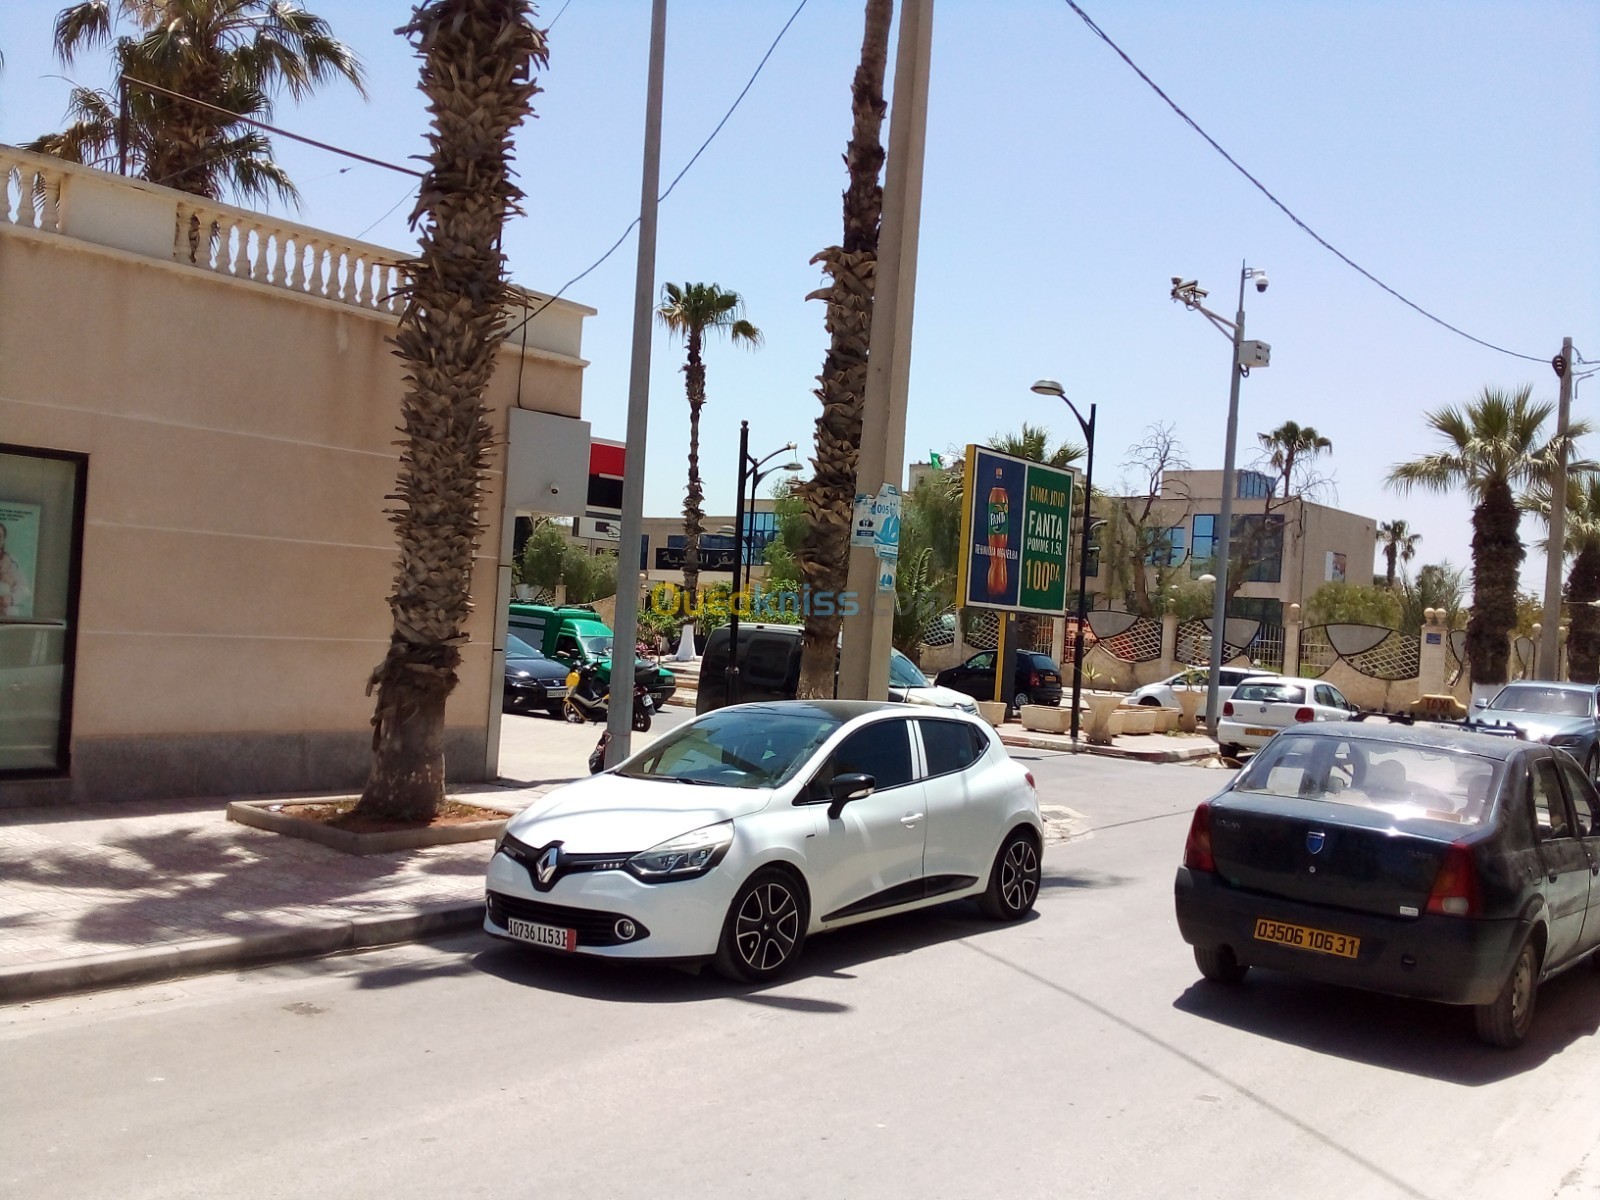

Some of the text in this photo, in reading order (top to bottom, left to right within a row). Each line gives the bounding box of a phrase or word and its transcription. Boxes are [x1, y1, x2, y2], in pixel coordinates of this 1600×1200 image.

[1028, 510, 1063, 541] FANTA
[1027, 537, 1049, 554] POMME
[1423, 697, 1450, 712] TAXI
[1257, 921, 1356, 956] 03506 106 31
